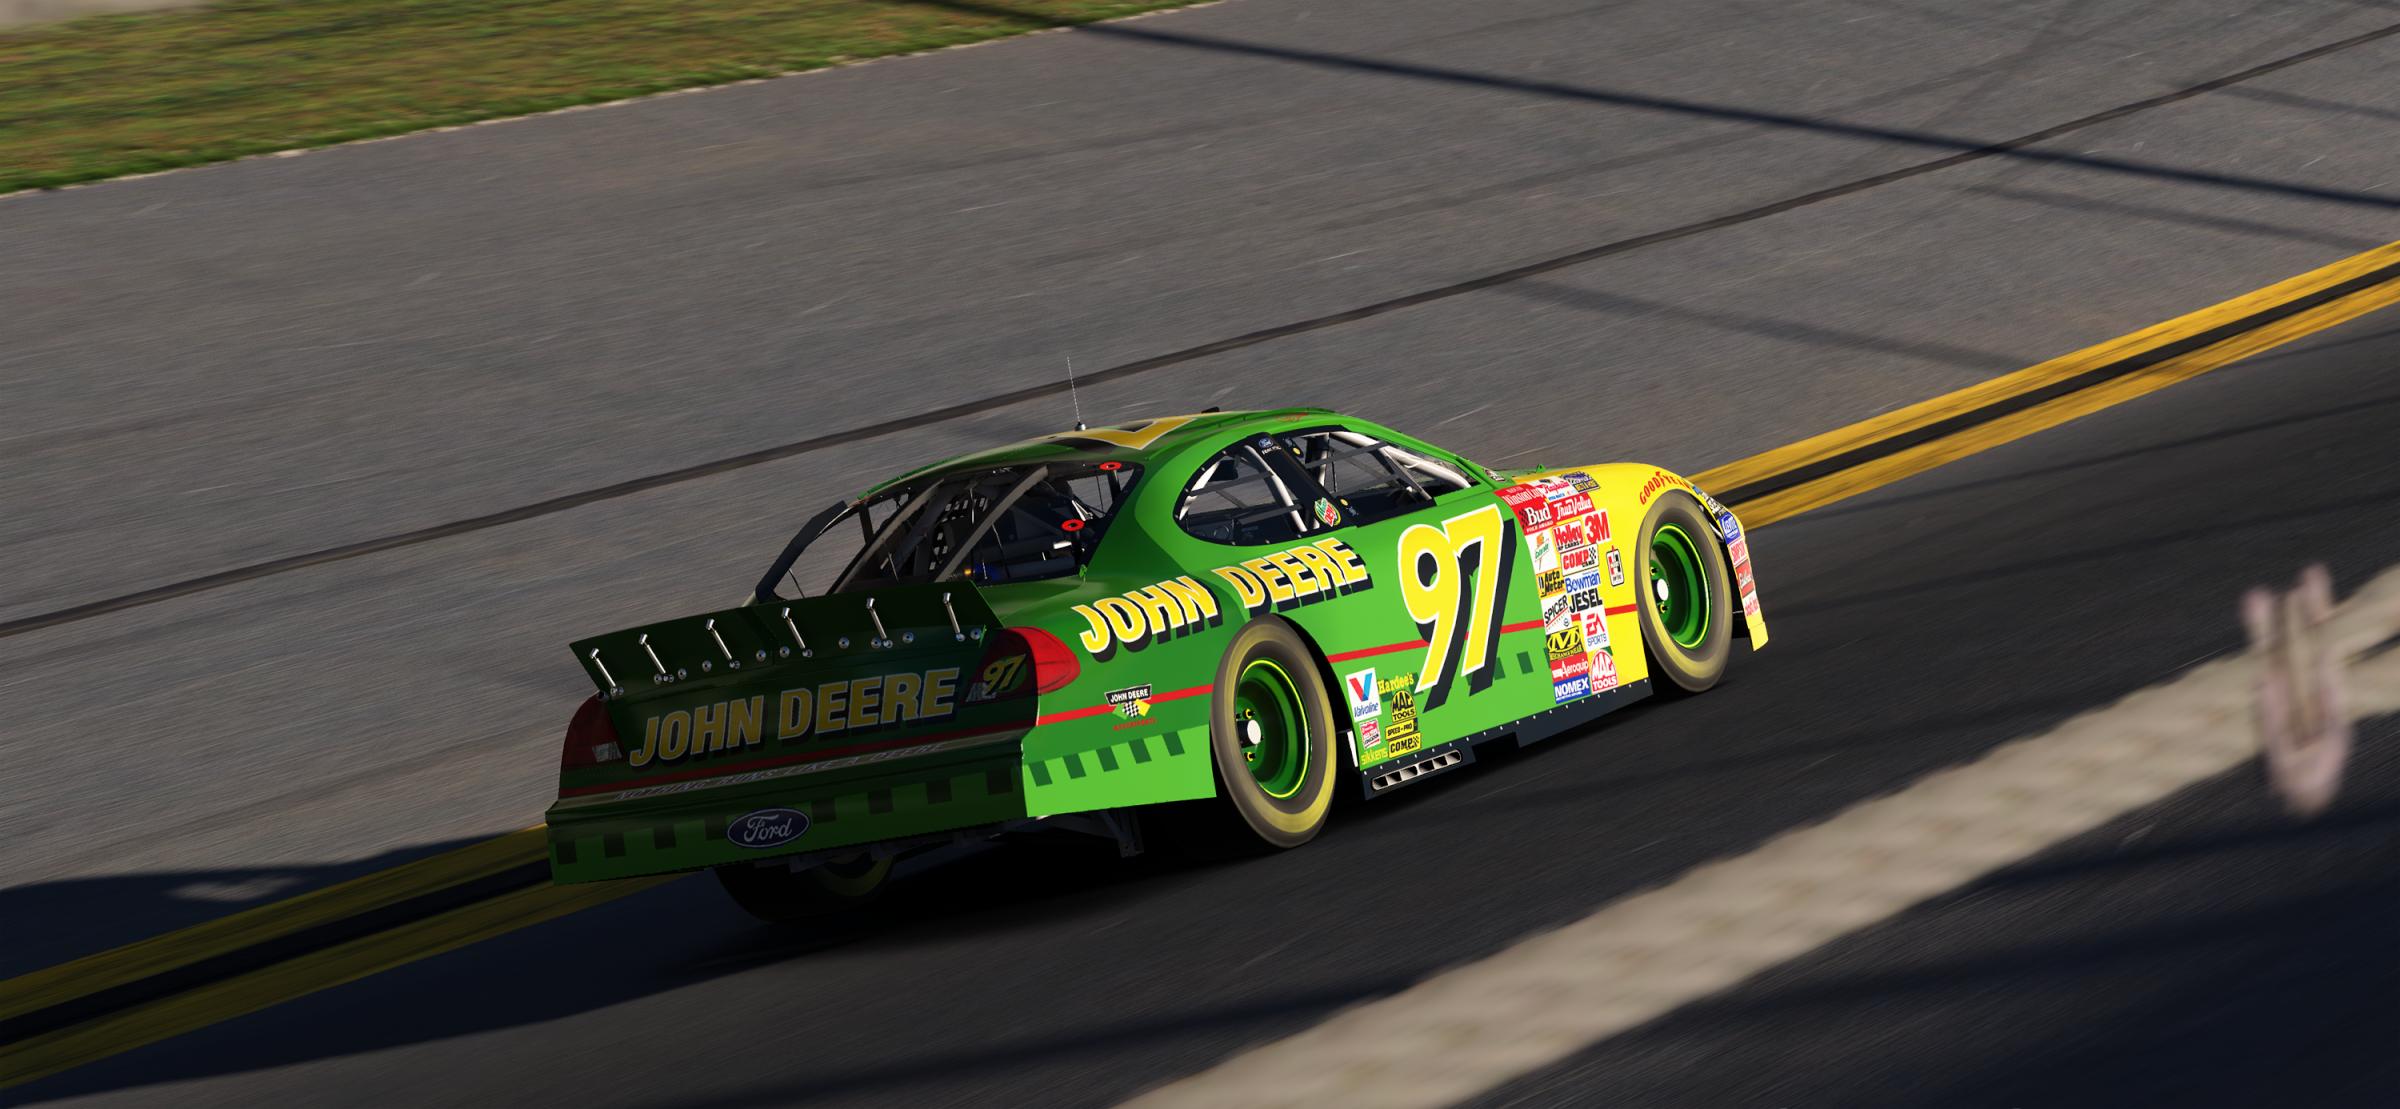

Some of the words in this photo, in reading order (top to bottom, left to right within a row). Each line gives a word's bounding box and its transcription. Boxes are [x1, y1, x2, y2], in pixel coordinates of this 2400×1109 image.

[1525, 501, 1552, 526] Bud
[1553, 524, 1584, 547] Holley
[1584, 510, 1610, 545] 3M
[1562, 549, 1589, 570] COMP
[1544, 579, 1565, 593] Meter
[1545, 569, 1561, 582] Auto
[1564, 572, 1601, 594] Bowman
[1071, 575, 1219, 654] JOHN
[1211, 537, 1368, 609] DEERE
[1397, 503, 1505, 694] 97
[1569, 587, 1603, 614] JESEL
[1543, 595, 1569, 625] SPICER
[1586, 612, 1605, 637] EA
[1587, 633, 1607, 647] SPORTS
[983, 653, 1027, 696] 97
[1562, 659, 1589, 678] Aeroquip
[1592, 652, 1615, 681] MAC
[1378, 672, 1414, 694] Hardee's
[1555, 677, 1590, 698] NOMEX
[1593, 675, 1617, 691] TOOLS
[1110, 693, 1128, 703] JOHN
[1127, 688, 1149, 700] DEERE
[1392, 691, 1414, 713] MAC
[628, 693, 764, 768] JOHN
[777, 667, 960, 741] DEERE
[1354, 702, 1379, 718] Valvoline
[1393, 709, 1415, 720] TOOLS
[1390, 737, 1413, 754] COMP
[742, 815, 794, 844] Ford
